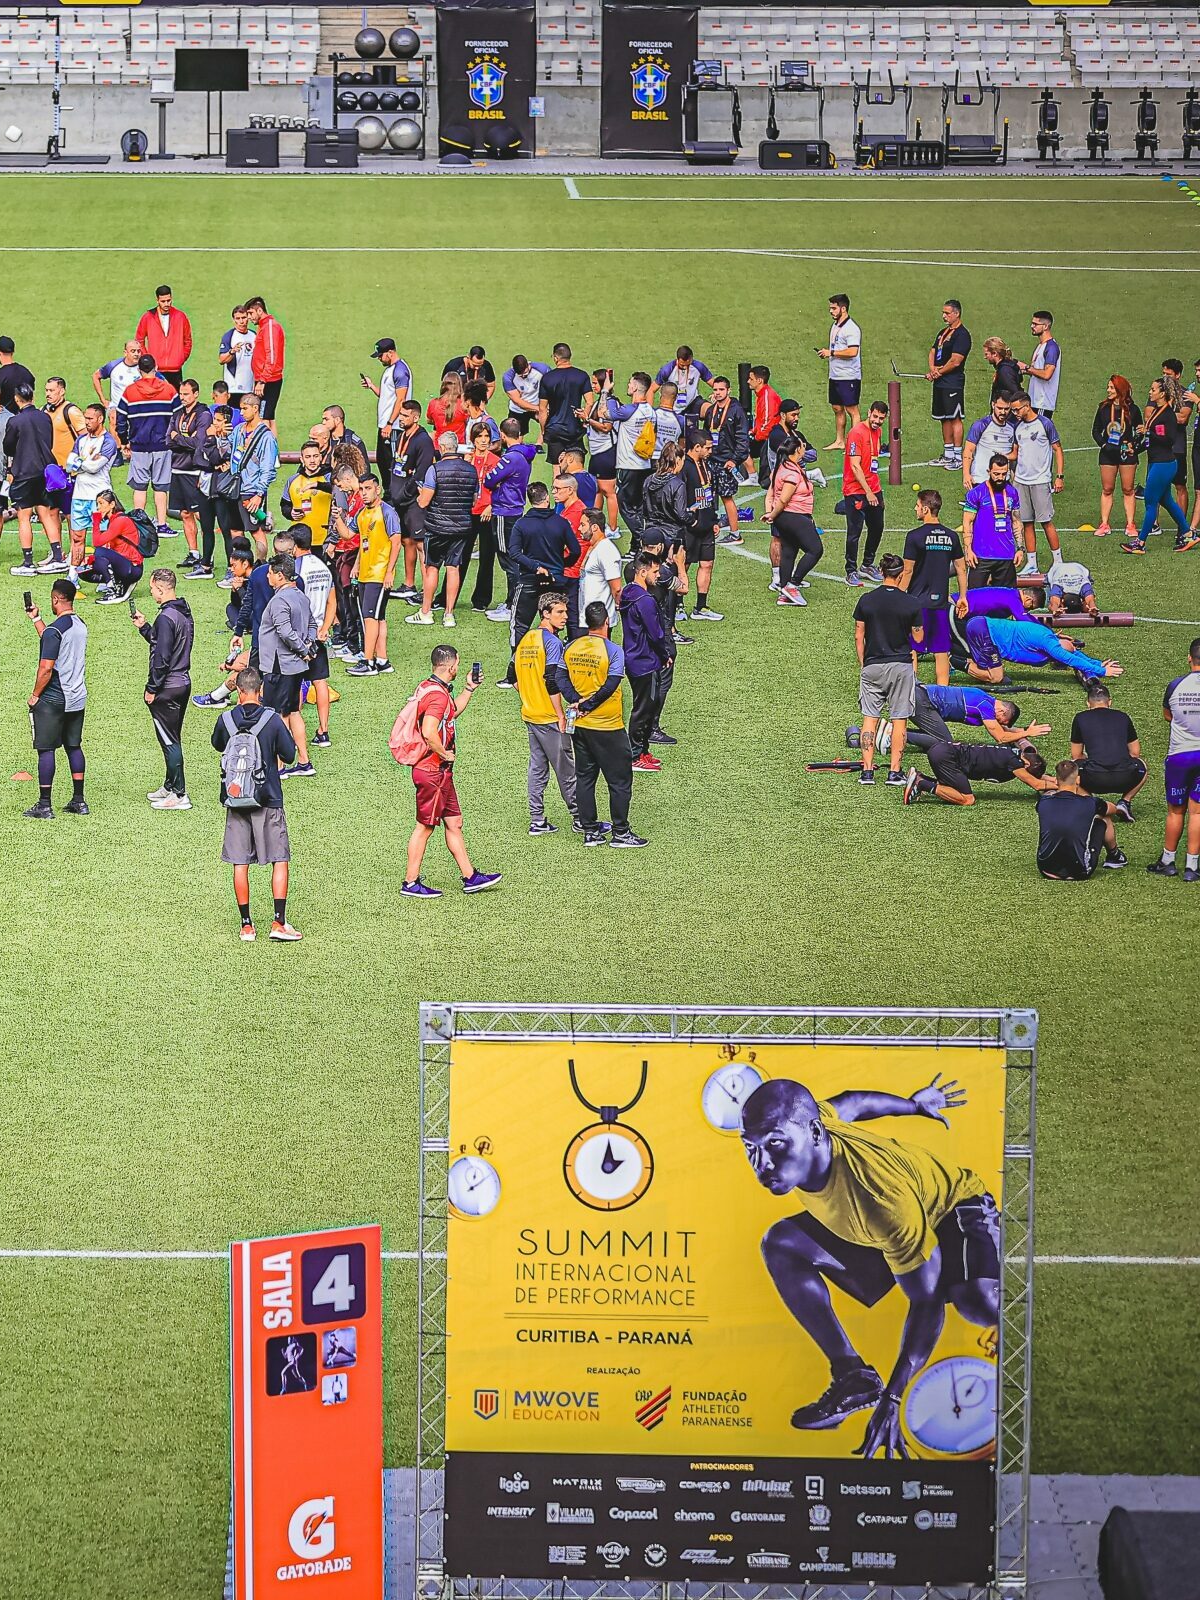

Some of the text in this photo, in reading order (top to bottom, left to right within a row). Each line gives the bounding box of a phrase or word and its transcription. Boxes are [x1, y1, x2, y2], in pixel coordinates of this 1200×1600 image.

[468, 110, 506, 119] BRASIL
[631, 111, 669, 120] BRASIL
[925, 535, 953, 545] ATLETA
[517, 1228, 696, 1258] SUMMIT
[515, 1262, 696, 1283] INTERNACIONAL
[311, 1253, 355, 1312] 4
[262, 1250, 293, 1329] SALA
[515, 1287, 695, 1306] DE PERFORMANCE
[516, 1329, 600, 1344] CURITIBA
[618, 1328, 693, 1345] PARANÁ
[586, 1366, 641, 1377] REALIZAÇÃO
[513, 1389, 600, 1408] MWOVE
[682, 1389, 747, 1403] FUNDAÇÃO
[512, 1408, 600, 1421] EDUCATION
[682, 1404, 740, 1414] ATHLETICO
[682, 1416, 753, 1427] PARANAENSE
[690, 1462, 754, 1471] PATROCINADORES
[499, 1476, 530, 1493] ligga
[552, 1478, 603, 1486] MATRIX
[840, 1483, 891, 1496] betsson
[486, 1506, 536, 1517] INTENSITY
[559, 1507, 593, 1517] VILLARTA
[609, 1507, 658, 1522] Copacol
[674, 1508, 715, 1521] chroma
[742, 1513, 786, 1523] GATORADE
[864, 1515, 908, 1525] CATAPULT
[708, 1533, 734, 1542] APOIO
[276, 1556, 352, 1581] GATORADE
